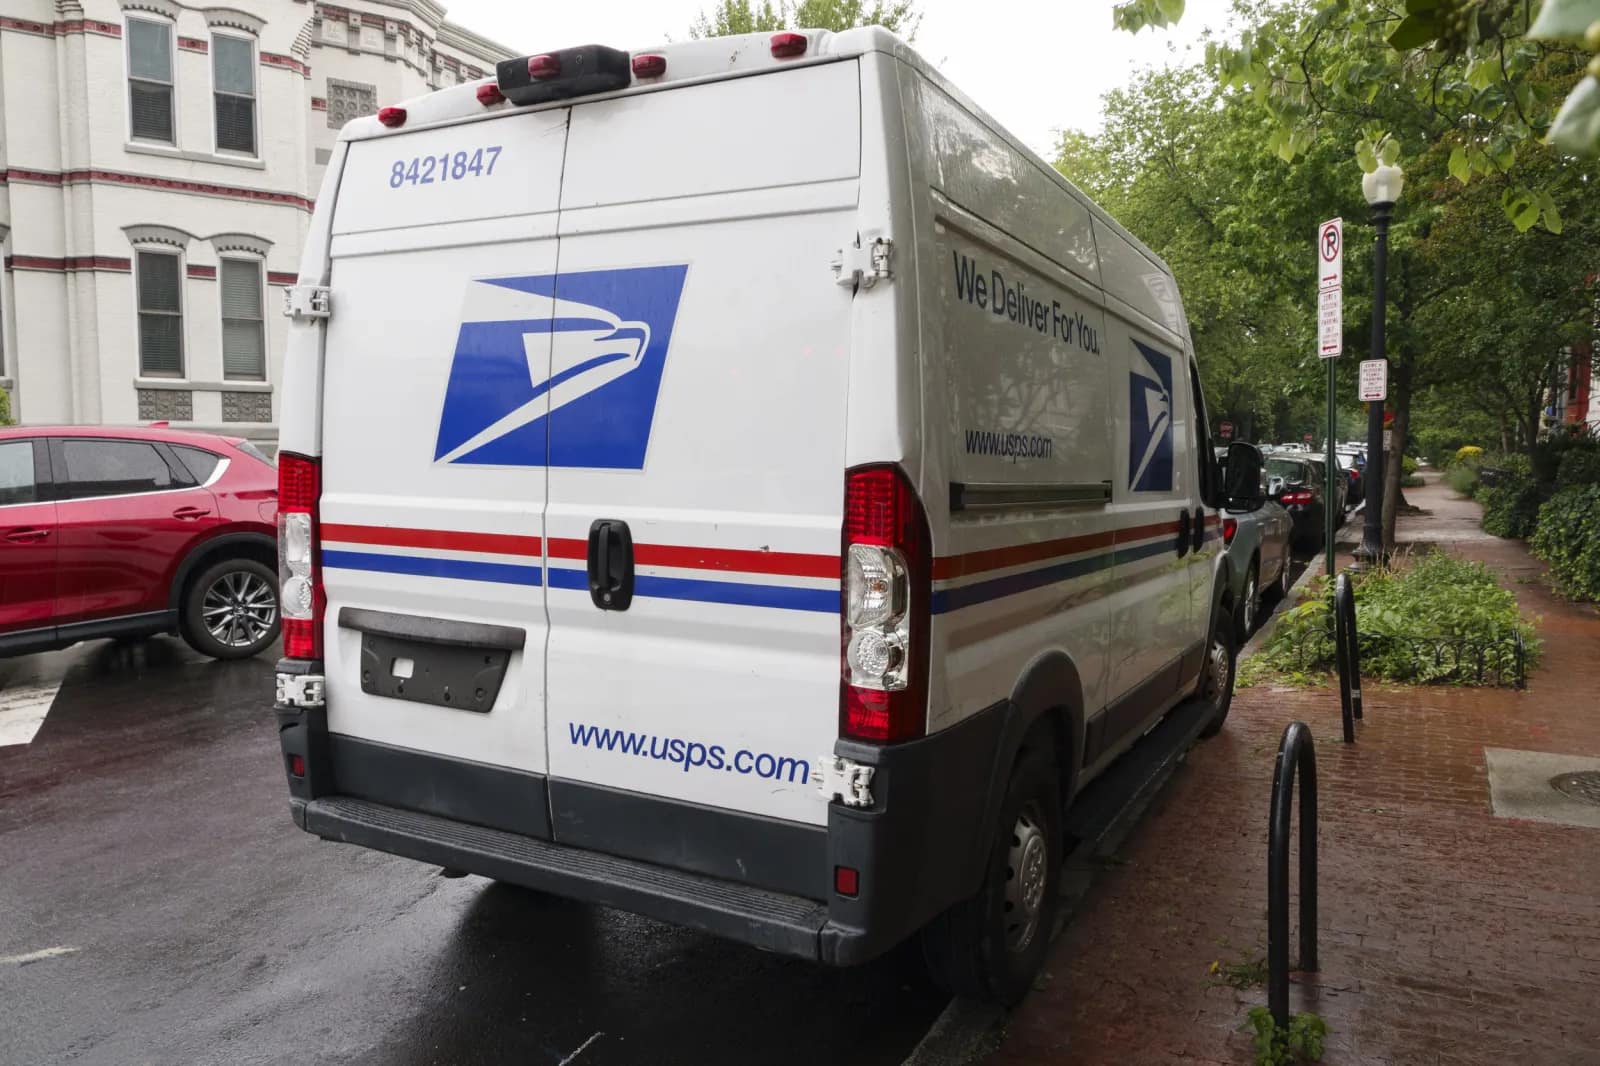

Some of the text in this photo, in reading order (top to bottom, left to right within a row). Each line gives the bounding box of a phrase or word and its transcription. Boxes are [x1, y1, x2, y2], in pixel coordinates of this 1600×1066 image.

[389, 145, 503, 189] 8421847
[953, 250, 1101, 356] We Deliver For You.
[965, 429, 1053, 465] www.usps.com
[569, 722, 811, 785] www.usps.com
